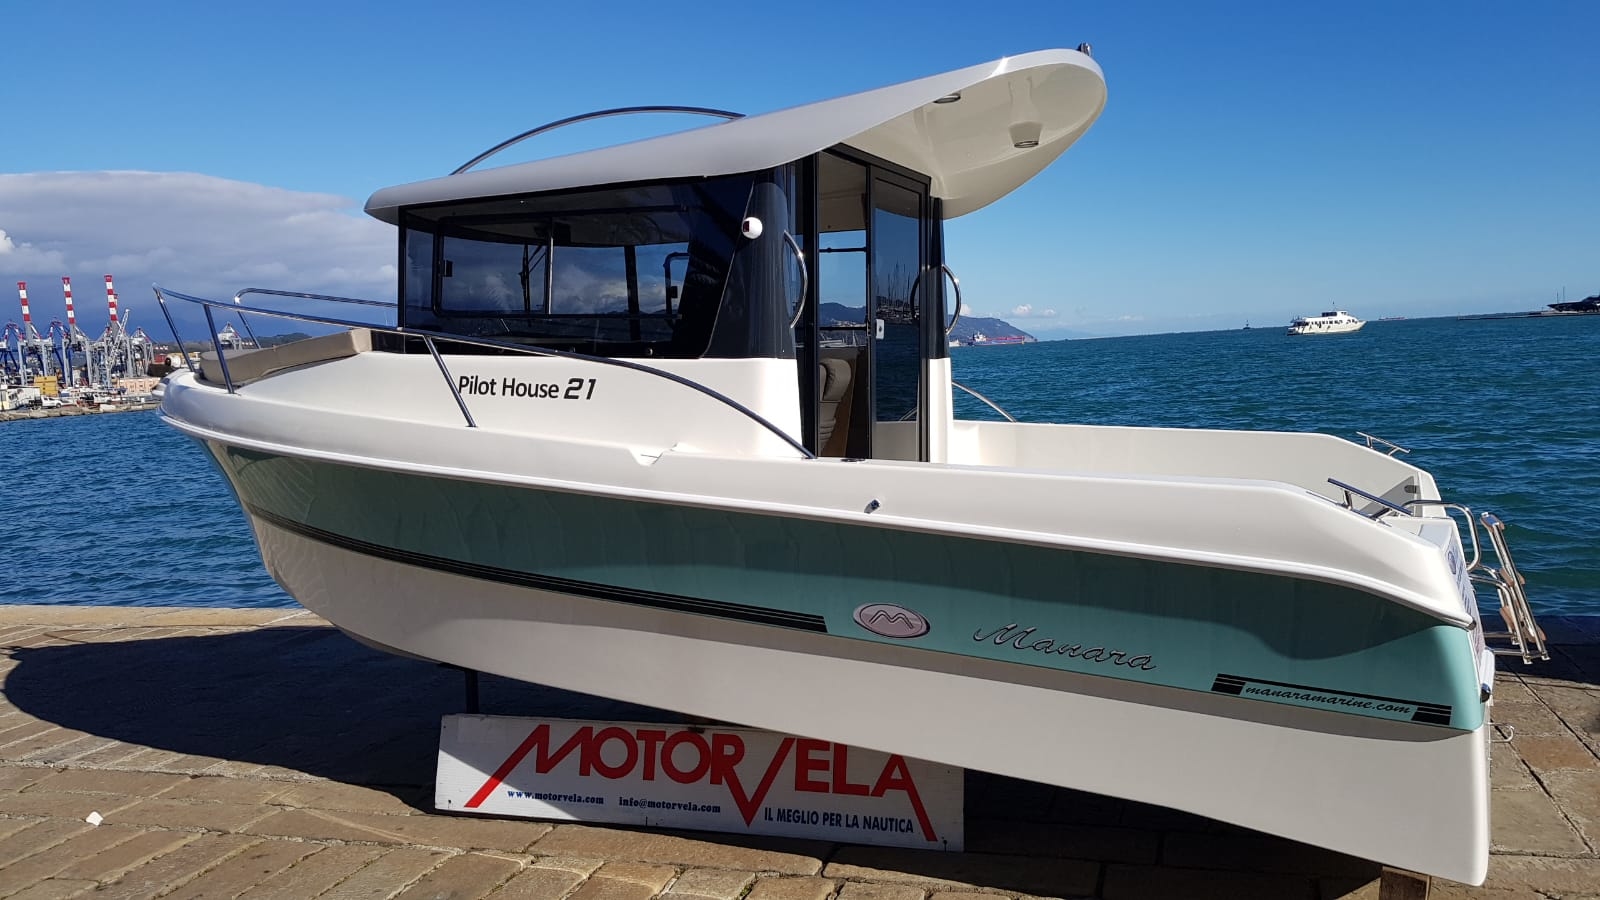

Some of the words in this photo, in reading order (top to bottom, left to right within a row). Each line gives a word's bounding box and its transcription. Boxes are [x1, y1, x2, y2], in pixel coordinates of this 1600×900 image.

[458, 375, 497, 395] Pilot
[502, 377, 559, 398] House
[563, 378, 597, 400] 21
[973, 623, 1157, 670] Manara
[1246, 686, 1411, 714] manaramarine.com
[507, 790, 604, 805] www.motorvela.com
[618, 796, 721, 813] info@motorvela.com
[764, 807, 773, 821] IL
[776, 808, 819, 825] MEGLIO
[822, 812, 842, 828] PER
[845, 814, 860, 829] LA
[863, 815, 914, 833] NAUTICA
